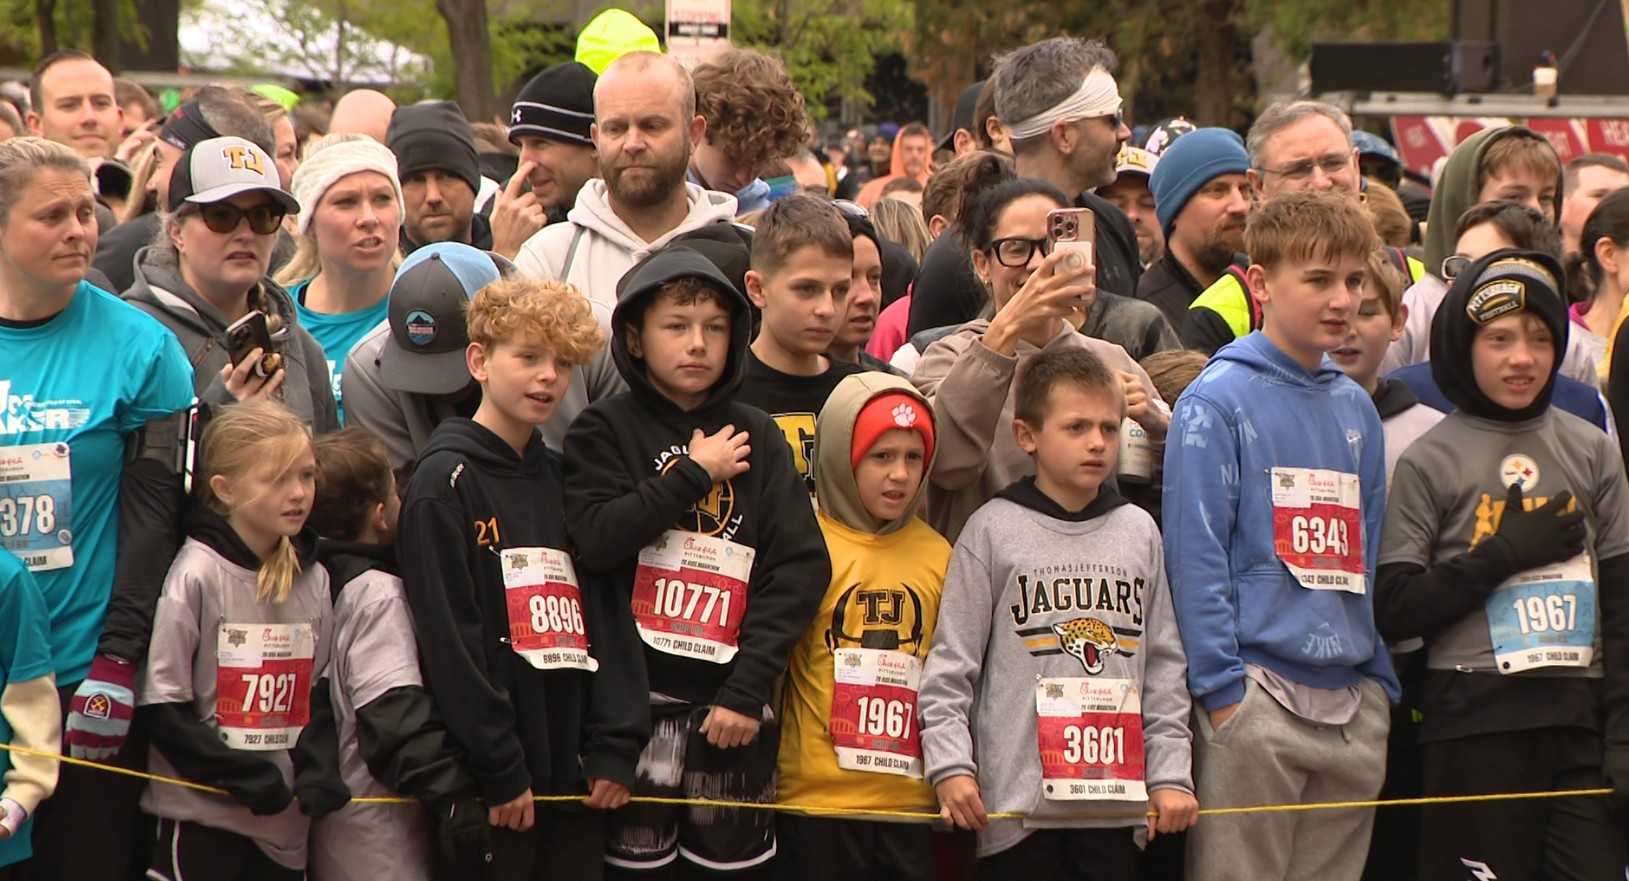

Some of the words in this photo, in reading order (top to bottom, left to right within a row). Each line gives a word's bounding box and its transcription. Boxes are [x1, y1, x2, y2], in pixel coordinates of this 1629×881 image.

[222, 146, 266, 176] TJ
[474, 517, 500, 546] 21
[1292, 516, 1349, 556] 6343
[529, 595, 584, 635] 8896
[654, 578, 731, 627] 10771
[857, 591, 905, 625] TJ
[1010, 575, 1145, 626] JAGUARS
[1513, 594, 1576, 634] 1967
[672, 640, 692, 652] CHILD
[693, 643, 716, 656] CLAIM
[242, 673, 296, 713] 7927
[858, 697, 913, 740] 1967
[874, 756, 892, 768] CHILD
[1064, 725, 1124, 764] 3601
[1070, 784, 1086, 795] 3601
[1108, 785, 1126, 794] CLAIM
